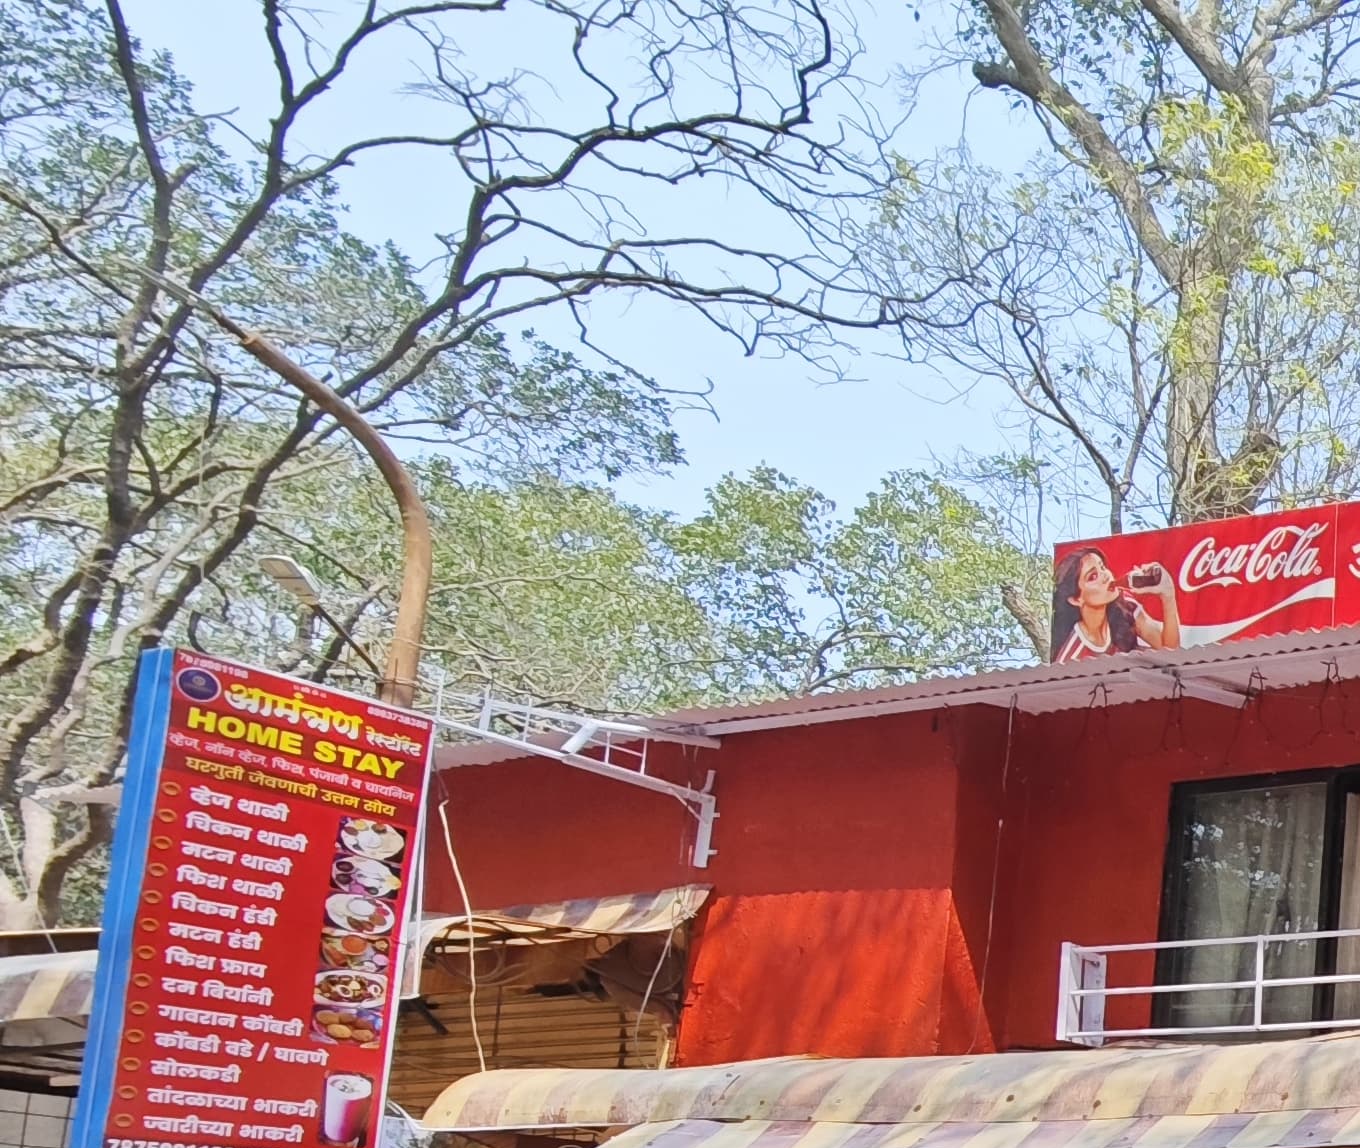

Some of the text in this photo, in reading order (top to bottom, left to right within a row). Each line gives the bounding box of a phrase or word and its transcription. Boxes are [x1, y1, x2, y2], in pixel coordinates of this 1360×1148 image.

[1178, 521, 1328, 591] Coca-Cola
[225, 683, 363, 740] आमंत्रण
[187, 707, 404, 779] HOME STAY
[185, 755, 397, 816] घरगुती जेवणाची उत्तम सोय
[189, 785, 290, 822] व्हेज थाळी
[186, 811, 309, 853] चिकन थाळी
[181, 841, 293, 876] मटन थाळी
[177, 864, 285, 900] फिश थाळी
[171, 891, 278, 926] चिकन हंडी
[168, 922, 263, 950] मटन हंडी
[165, 946, 216, 970] फिश
[162, 976, 198, 995] दम
[158, 1003, 238, 1028] गावरान
[225, 1039, 253, 1058] वडे
[256, 1042, 270, 1062] /
[150, 1057, 242, 1083] सोलकडी
[147, 1086, 318, 1118] तांदळाच्या भाकरी
[143, 1114, 304, 1143] ज्वारीच्या भाकरी
